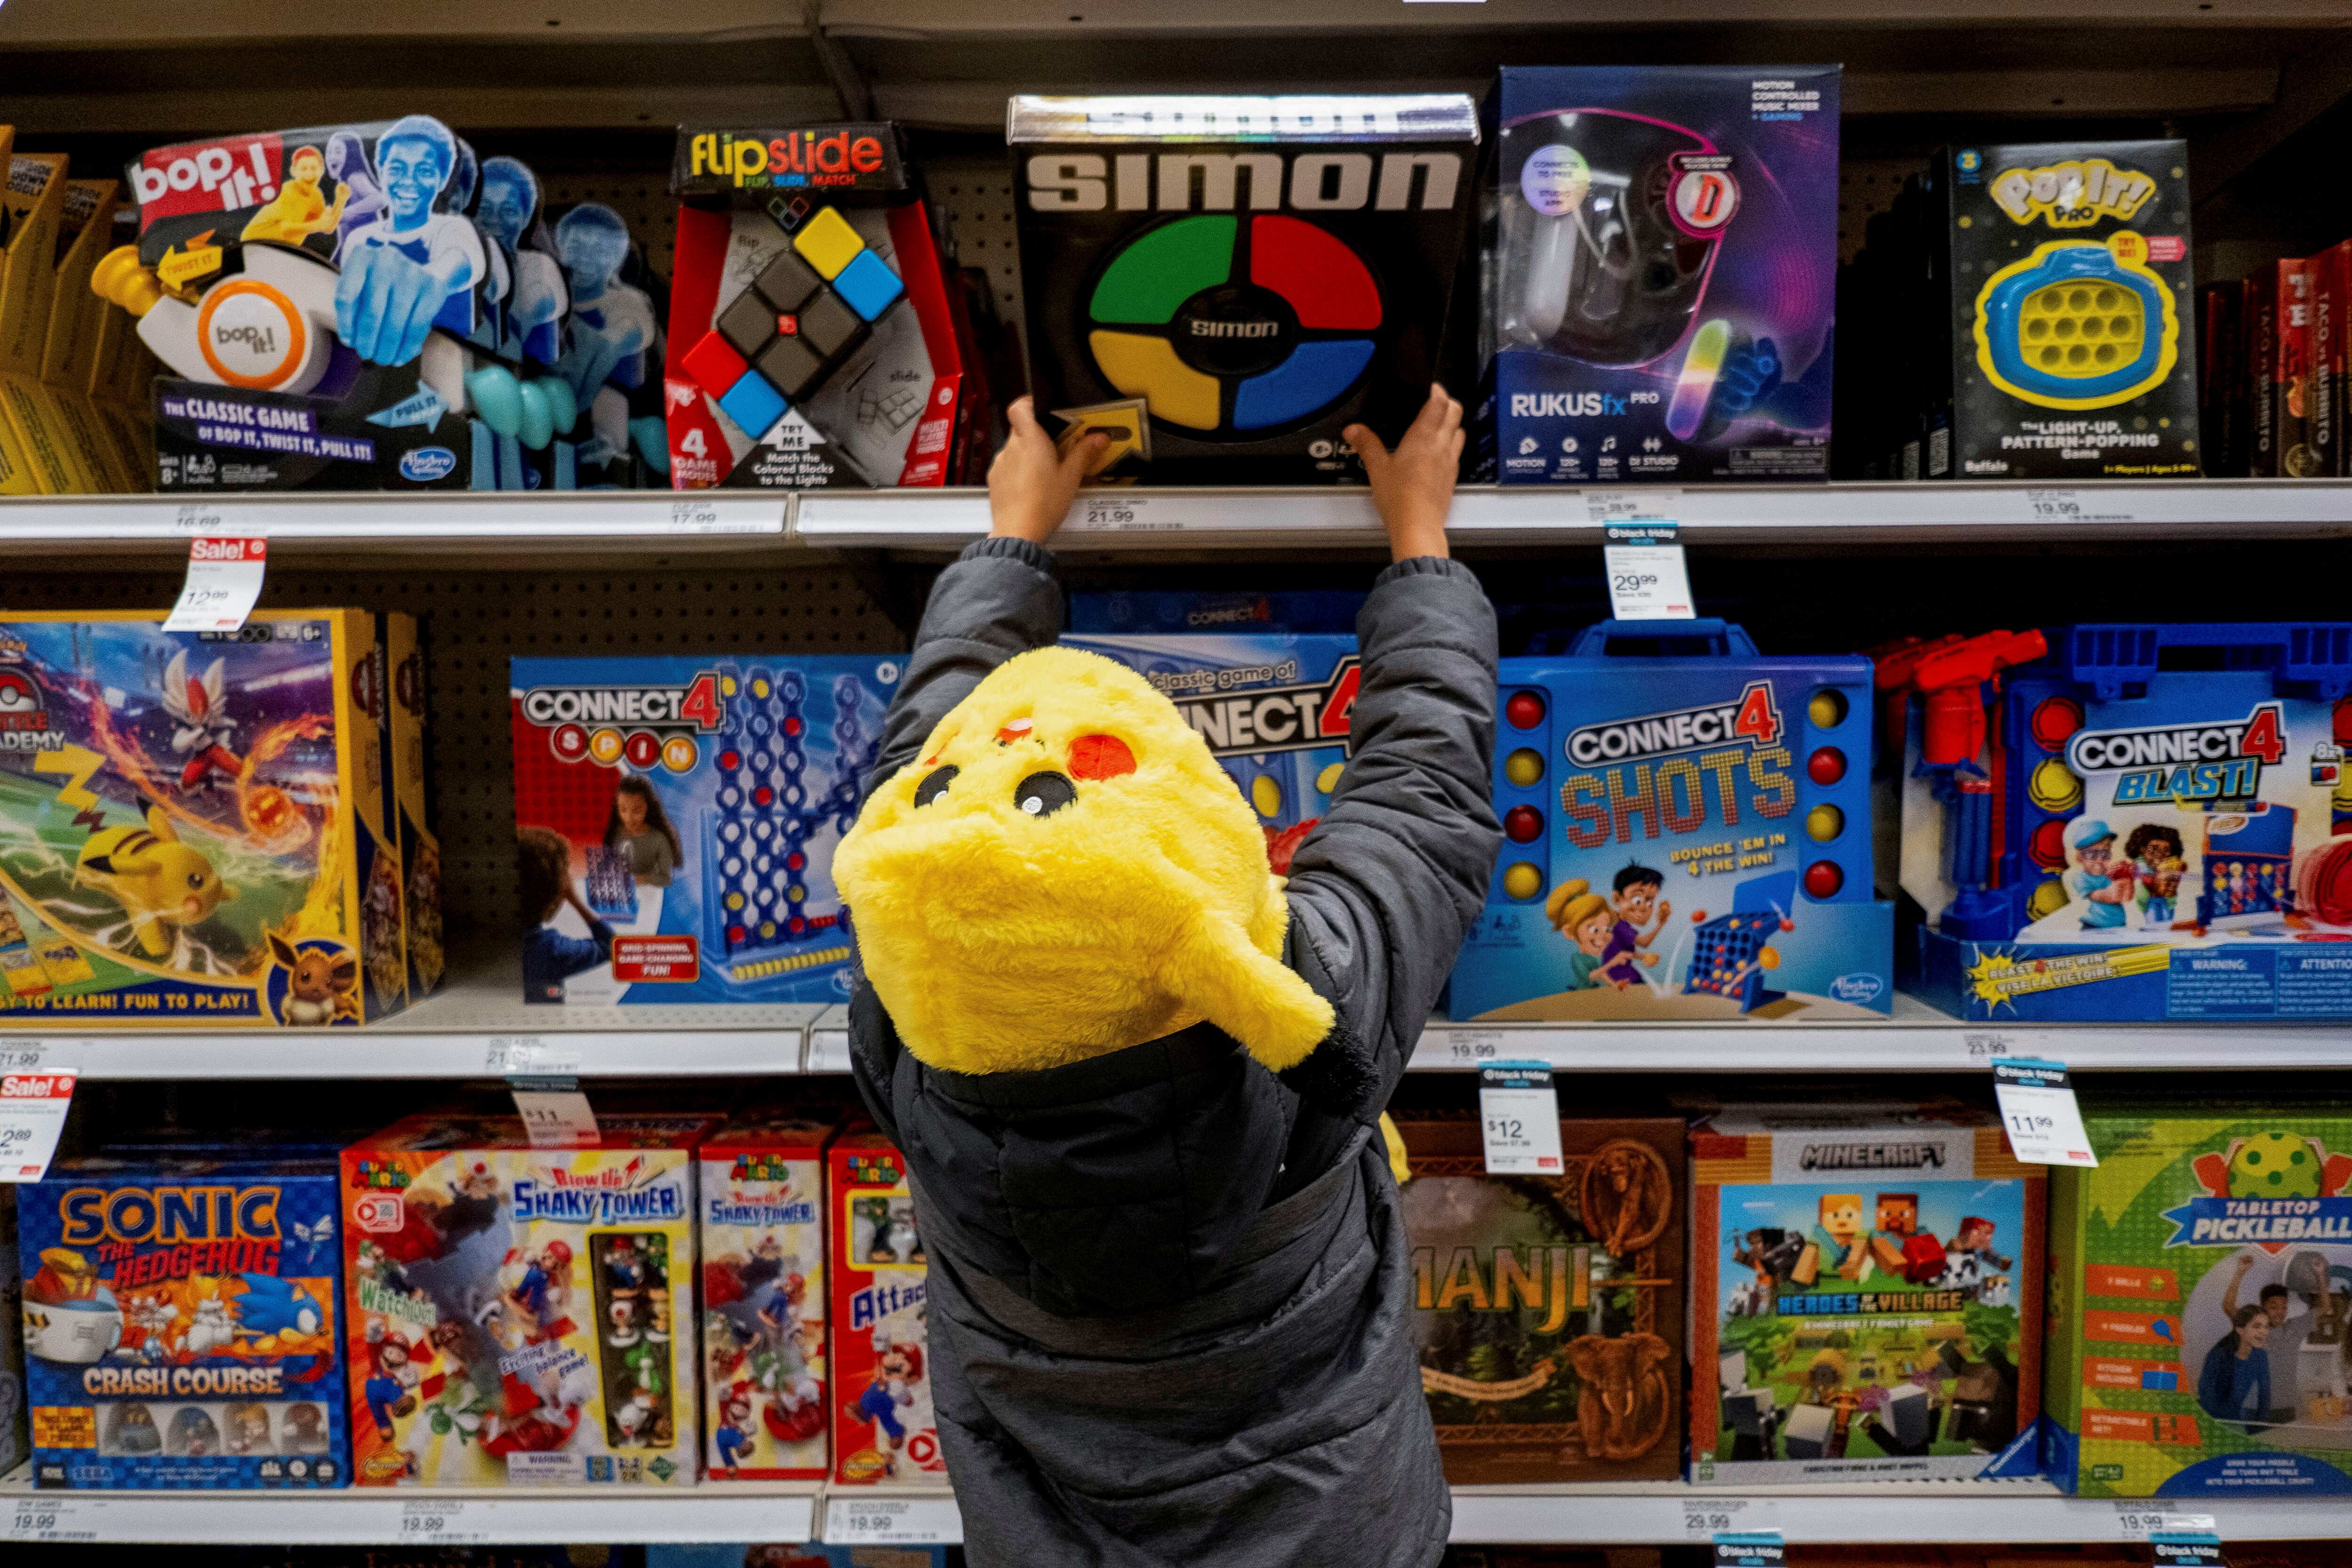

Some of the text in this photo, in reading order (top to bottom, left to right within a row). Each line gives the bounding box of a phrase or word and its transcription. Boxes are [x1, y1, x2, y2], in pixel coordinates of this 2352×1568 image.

[1997, 167, 2152, 216] POP IT!
[2054, 205, 2093, 222] PRO
[1511, 393, 1660, 416] RUKUSfx PRO
[2317, 364, 2330, 445] BURRITO
[165, 398, 310, 432] THE CLASSIC GAME
[780, 425, 803, 435] TRY
[199, 426, 213, 439] OF
[215, 428, 240, 441] BOP
[262, 434, 301, 451] TWIST
[321, 440, 353, 459] PULL
[354, 444, 372, 461] IT!
[681, 428, 707, 458] 4
[782, 436, 804, 448] ME
[2001, 434, 2159, 449] PATTERN-POPPING
[674, 457, 718, 470] GAME
[766, 452, 820, 465] Match the
[1507, 459, 1545, 468] MOTION
[1643, 456, 1679, 466] STUDIO
[2061, 448, 2100, 459] Game
[754, 464, 834, 475] Colored Blocks
[760, 474, 829, 488] to the Lights
[1088, 511, 1134, 523] 21.99
[2033, 502, 2080, 515] 19.99
[193, 540, 245, 560] Sale!
[1153, 661, 1296, 690] classic game of
[528, 675, 720, 728] CONNECT 4
[1571, 688, 1777, 763] CONNECT 4
[2080, 709, 2283, 768] CONNECT 4
[2115, 758, 2258, 802] BLAST!
[1560, 748, 1796, 849] SHOTS
[1670, 843, 1733, 863] BOUNCE
[1770, 834, 1786, 845] IN
[1688, 852, 1773, 877] 4 THE WIN!
[643, 966, 671, 977] FUN!
[2046, 960, 2072, 971] THE
[2192, 959, 2248, 971] WARNING:
[24, 994, 249, 1010] TO LEARN! FUN TO PLAY!
[1451, 1044, 1495, 1057] 19.99
[2, 1076, 54, 1096] Sale!
[1488, 1119, 1523, 1138] $12
[1800, 1143, 1946, 1171] MINECRAFT
[514, 1181, 676, 1221] SHAKY TOWER
[2226, 1200, 2321, 1216] TABLETOP
[59, 1186, 282, 1245] SONIC
[2192, 1216, 2352, 1240] PICKLEBALL
[98, 1241, 135, 1263] THE
[114, 1239, 281, 1291] HEDGEHOG
[1778, 1295, 1859, 1316] HEROES
[1878, 1291, 1963, 1312] VILLAGE
[84, 1366, 283, 1395] CRASH COURSE
[14, 1514, 56, 1529] 19.99
[849, 1516, 893, 1530] 19.99
[1685, 1514, 1730, 1529] 29.99
[2120, 1515, 2163, 1529] 19.99
